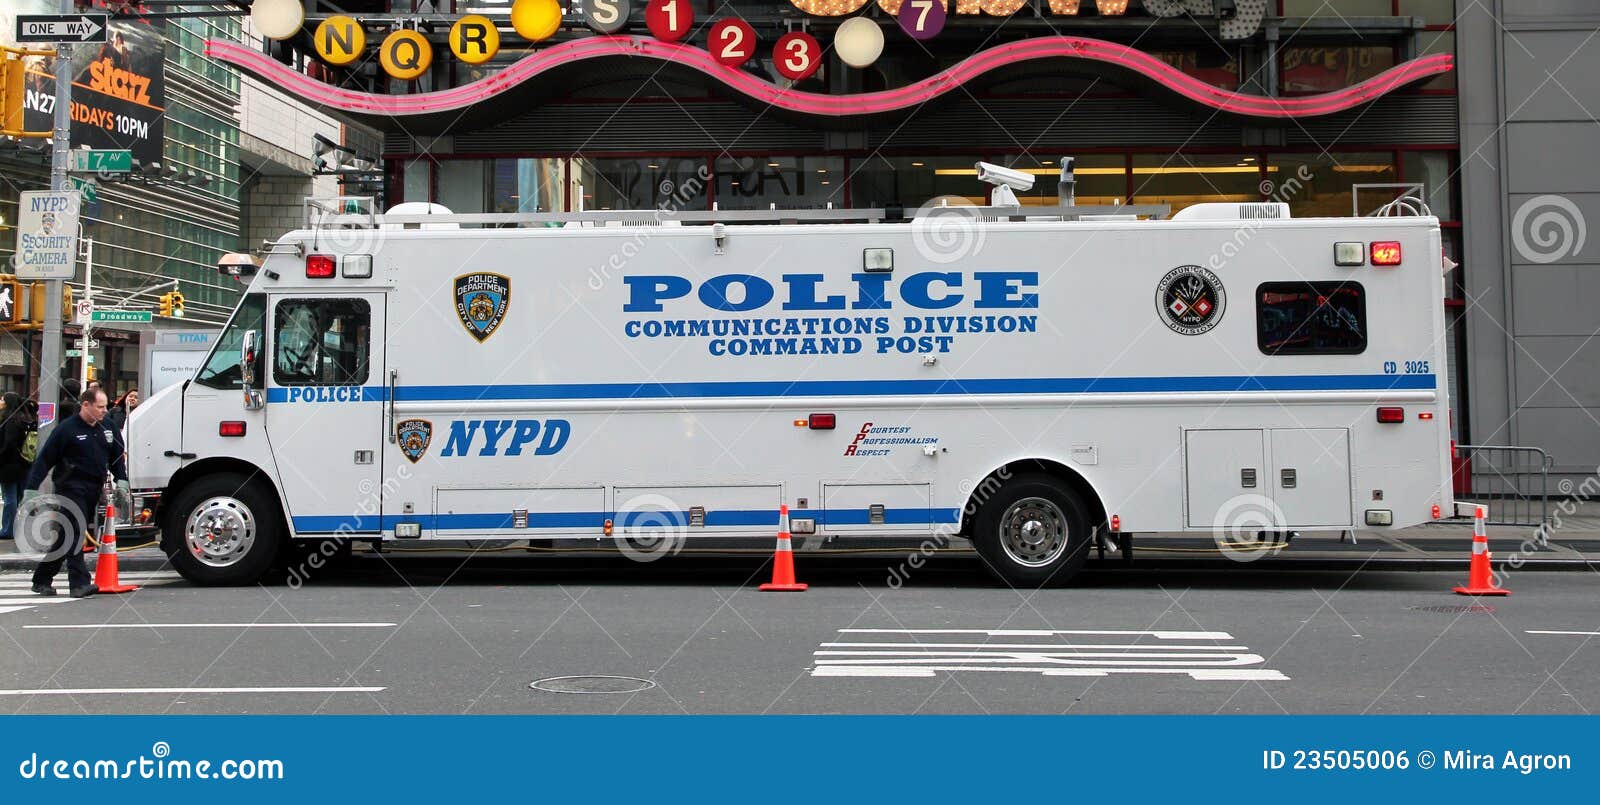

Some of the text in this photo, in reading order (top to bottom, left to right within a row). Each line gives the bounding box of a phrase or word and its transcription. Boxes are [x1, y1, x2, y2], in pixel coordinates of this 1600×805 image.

[29, 23, 93, 34] ONE WAY
[325, 24, 353, 55] N
[390, 38, 420, 70] Q
[460, 24, 487, 54] R
[593, 0, 619, 21] S
[660, 0, 677, 31] 1
[721, 26, 745, 58] 2
[785, 39, 809, 72] 3
[911, 0, 933, 31] 7
[70, 100, 148, 140] RIDAYS 10PM
[94, 153, 121, 169] 7 AV
[31, 197, 69, 212] NYPD
[22, 234, 72, 249] SECURITY
[23, 250, 68, 265] CAMERA
[468, 274, 499, 284] POLICE
[457, 282, 508, 296] DEPARTMENT
[622, 271, 1039, 313] POLICE
[100, 313, 143, 321] Broadway
[457, 302, 476, 332] CITY OF
[485, 299, 507, 334] NEW YORK
[624, 315, 1038, 338] COMMUNICATIONS DIVISION
[1170, 322, 1214, 334] DIVISION
[178, 333, 208, 343] TITAN
[708, 336, 954, 356] COMMAND POST
[1383, 361, 1430, 374] CD 3025
[289, 386, 361, 403] POLICE
[860, 422, 911, 434] COURTESY
[440, 418, 571, 457] NYPD
[852, 433, 938, 445] PROFESSIONALISM
[844, 444, 890, 456] RESPECT
